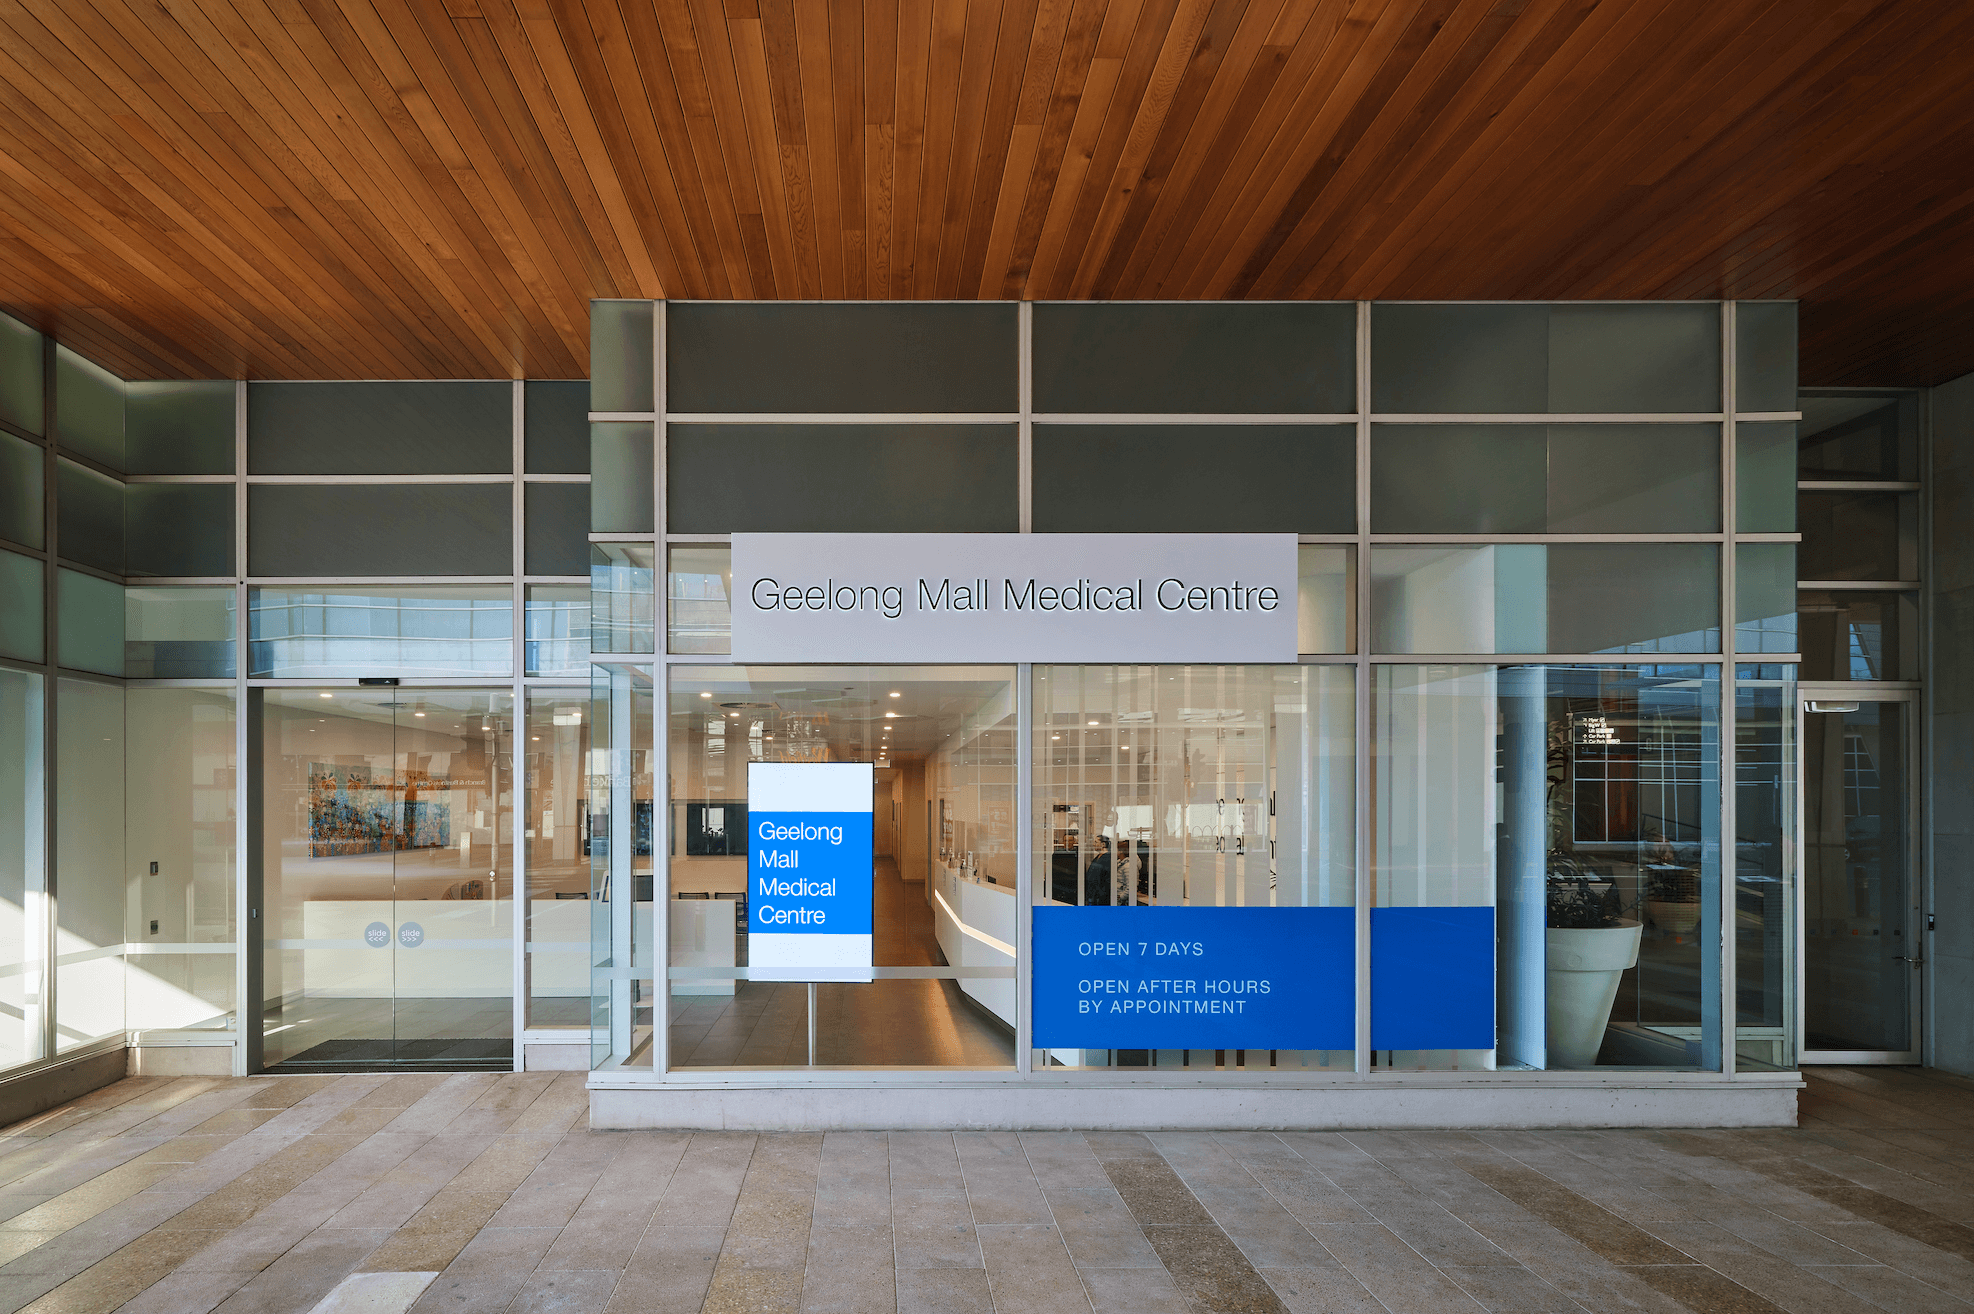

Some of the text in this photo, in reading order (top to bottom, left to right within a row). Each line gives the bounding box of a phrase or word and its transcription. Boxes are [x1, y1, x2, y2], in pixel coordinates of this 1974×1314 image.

[751, 577, 1279, 619] Geelong Mall Medical Centre
[758, 821, 843, 845] Geelong
[759, 849, 799, 868] Mall
[759, 877, 836, 897] Medical
[758, 905, 826, 925] Centre
[1078, 941, 1204, 957] OPEN 7 DAYS
[1078, 979, 1271, 994] OPEN AFTER HOURS
[1078, 999, 1247, 1014] BY APPOINTMENT
